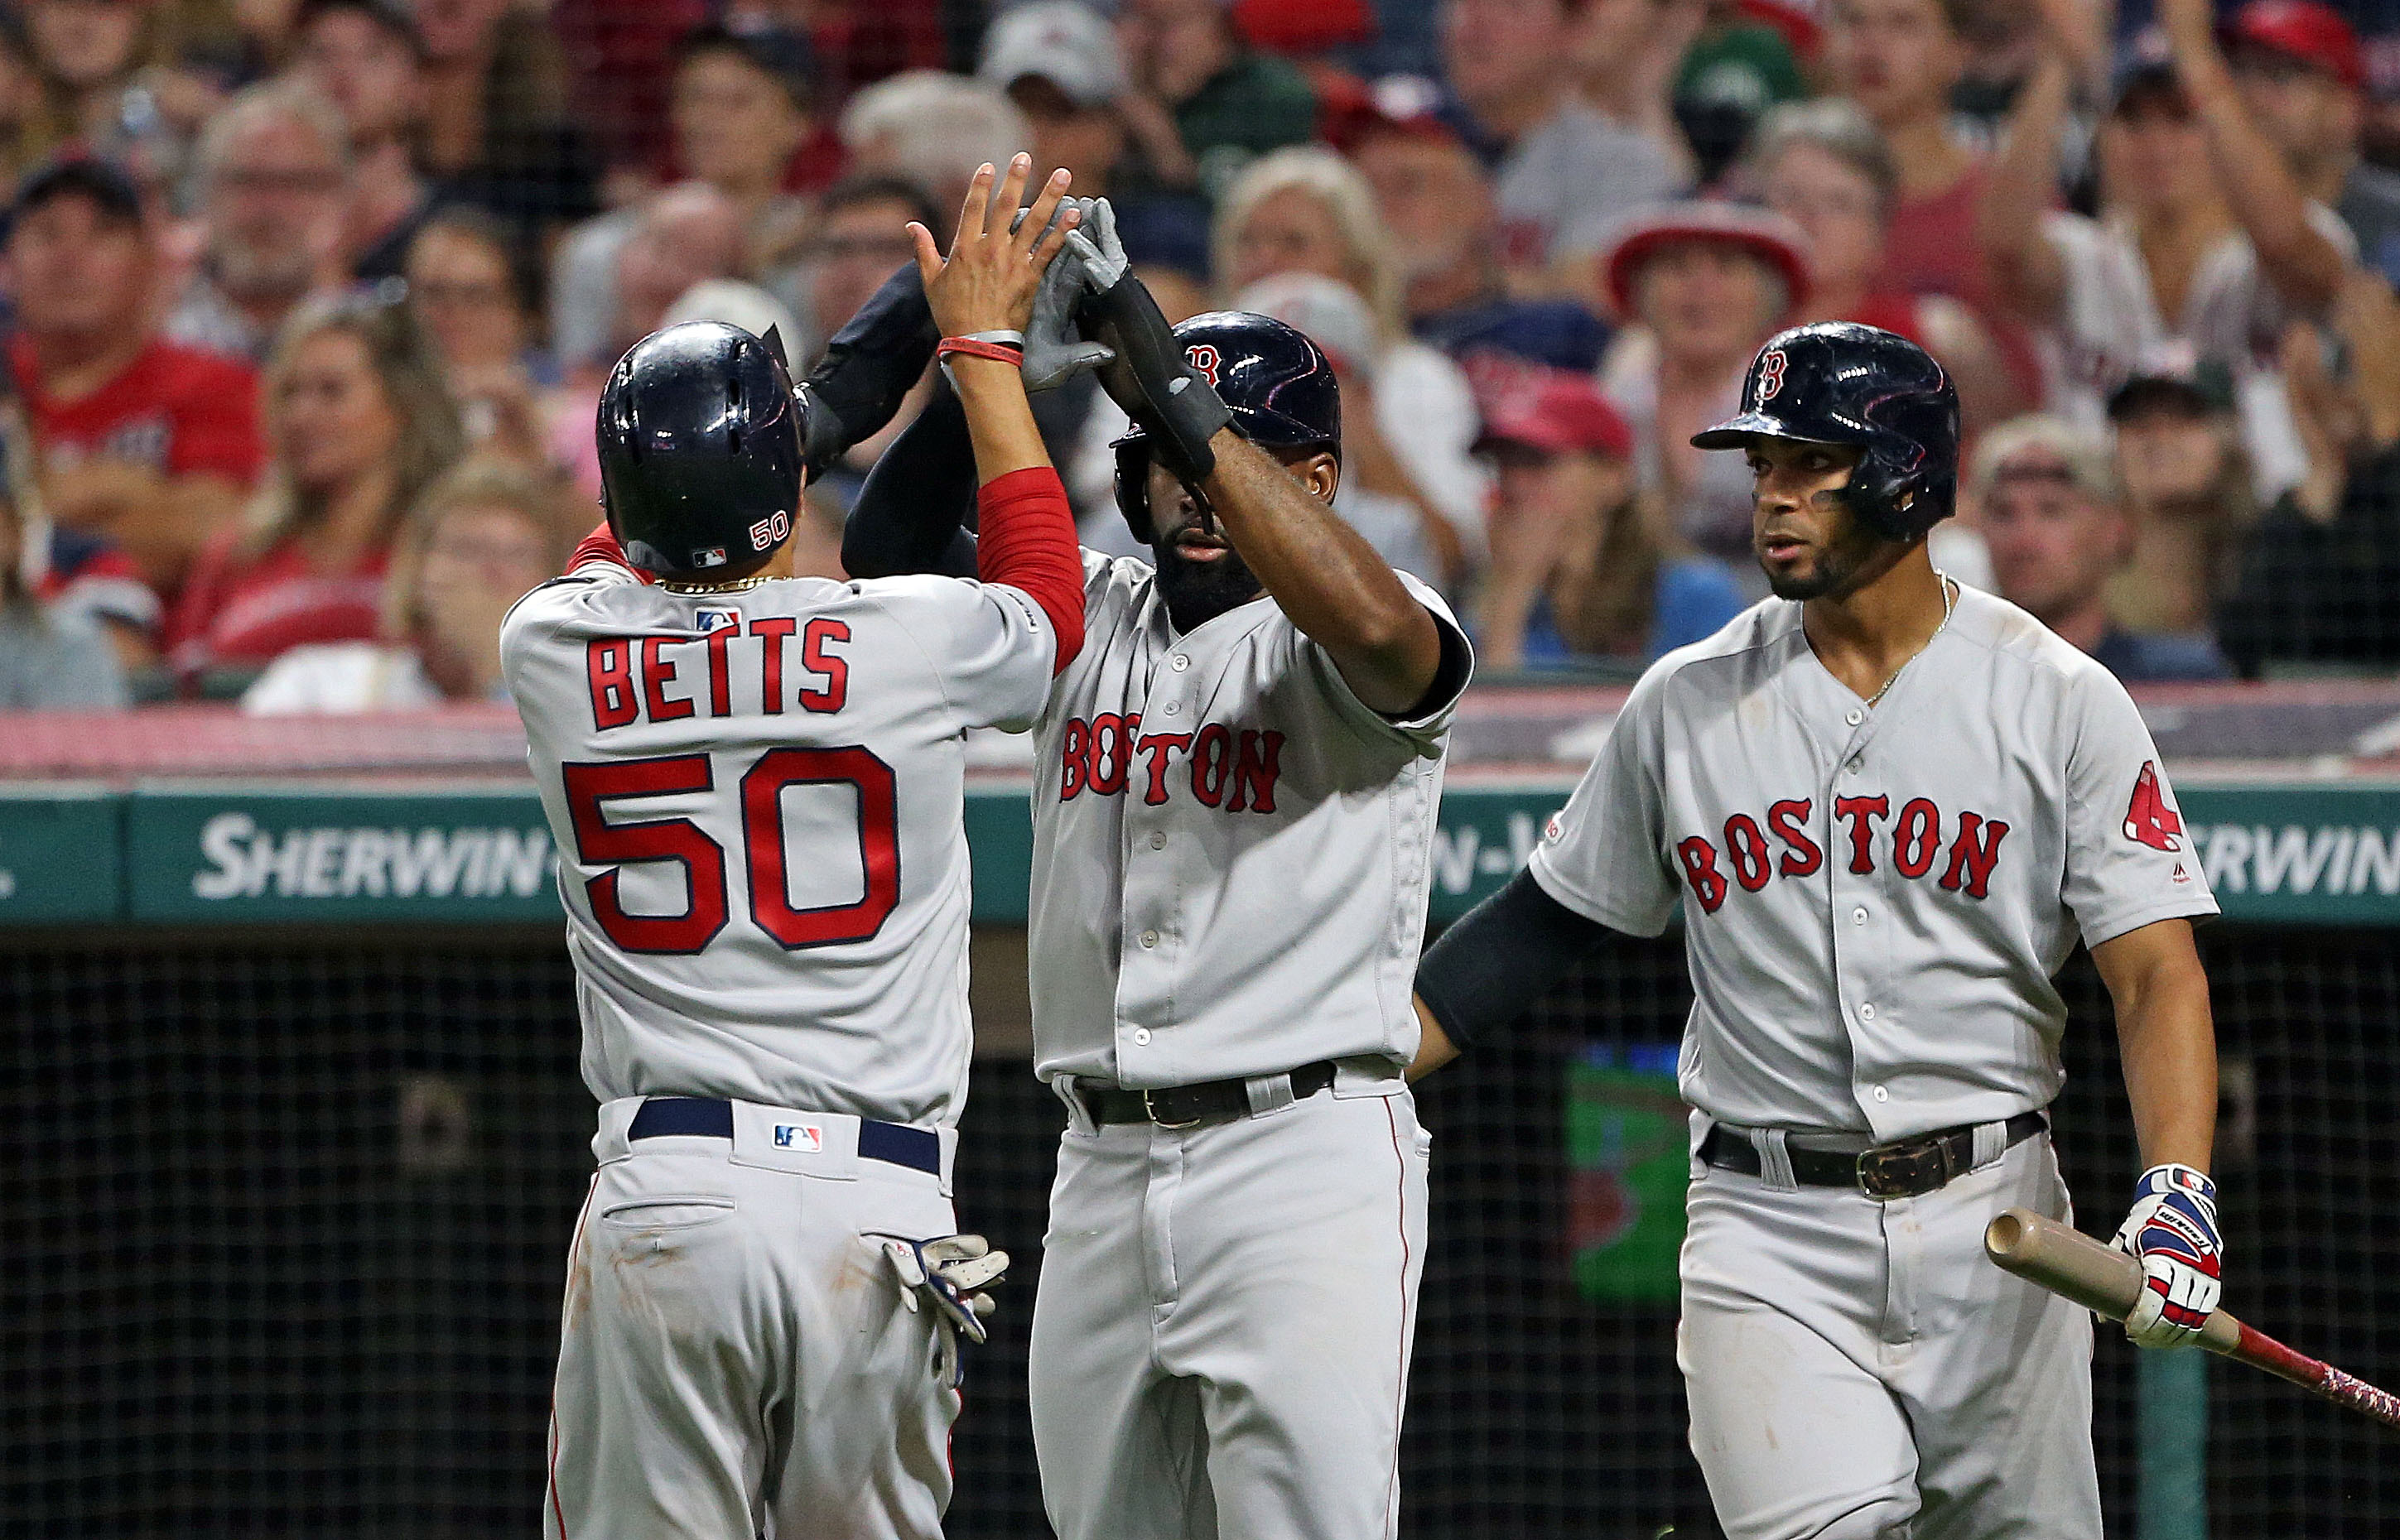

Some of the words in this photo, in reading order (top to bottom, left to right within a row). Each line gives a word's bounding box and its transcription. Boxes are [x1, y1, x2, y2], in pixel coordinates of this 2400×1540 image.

[1185, 344, 1222, 388] B
[1754, 350, 1788, 401] B
[749, 510, 789, 551] 50
[587, 617, 851, 732] BETTS
[563, 745, 899, 955] 50
[1678, 794, 2010, 915] BOSTON
